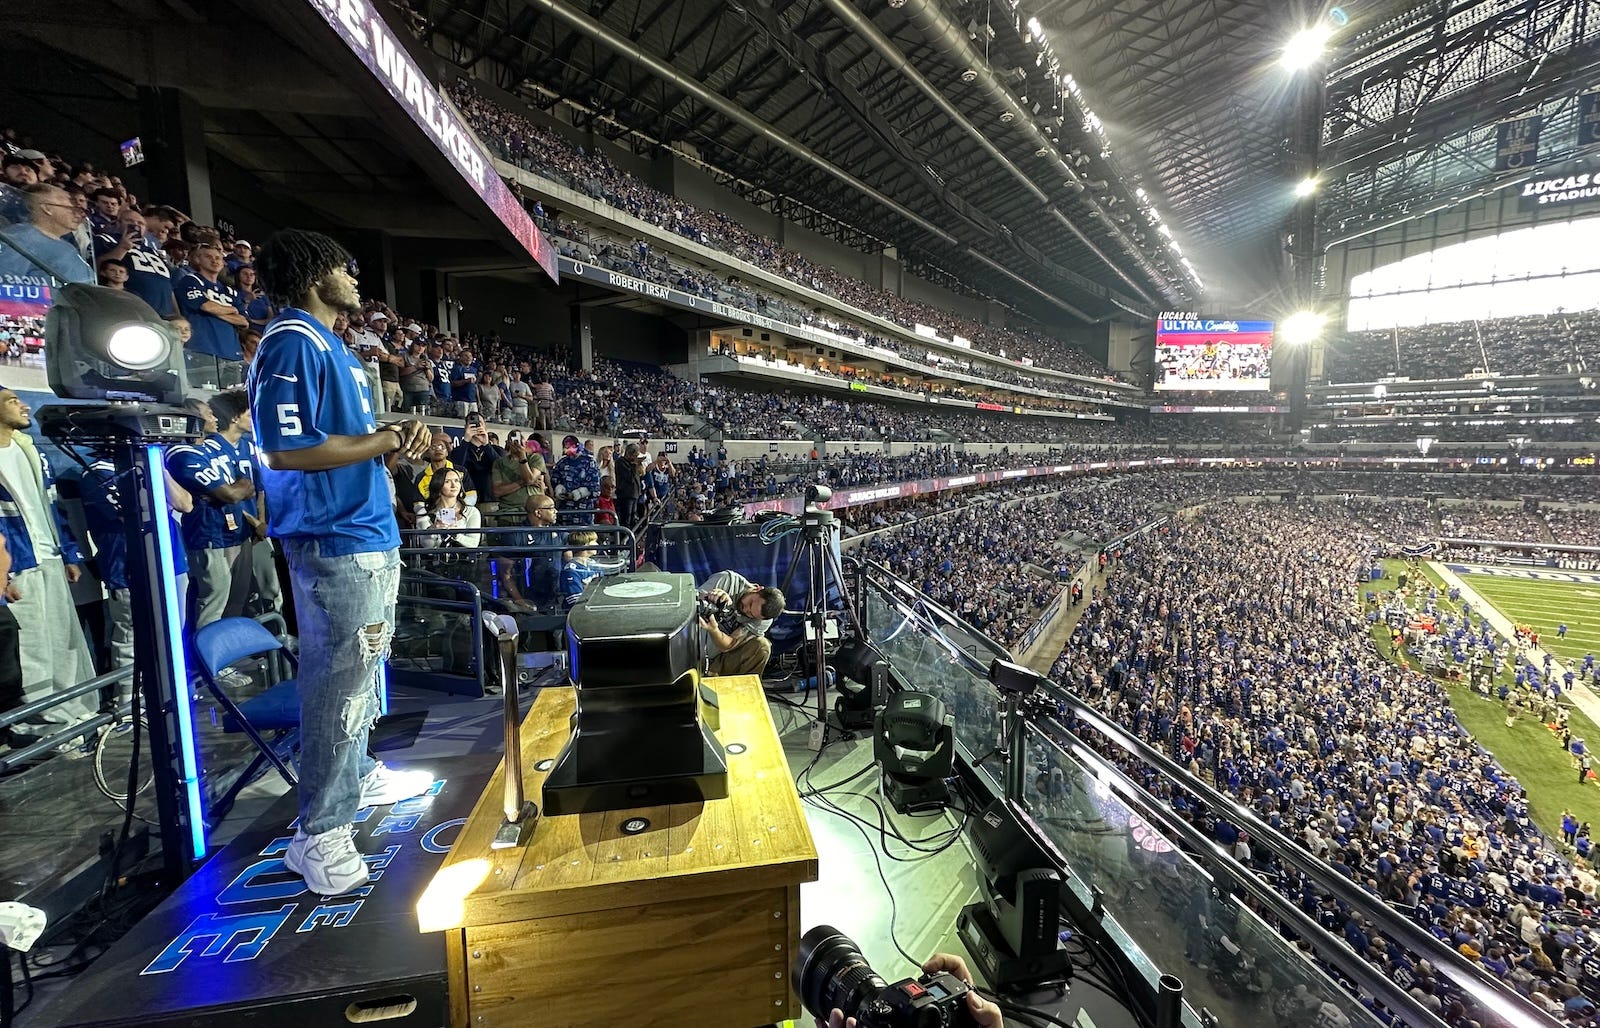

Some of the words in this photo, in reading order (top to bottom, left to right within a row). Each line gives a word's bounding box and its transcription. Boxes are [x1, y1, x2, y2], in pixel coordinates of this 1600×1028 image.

[370, 18, 486, 191] WALKER
[1521, 174, 1590, 197] LUCAS
[217, 219, 235, 236] 406
[130, 248, 171, 280] 28
[609, 273, 644, 293] ROBERT
[645, 283, 670, 300] IRSAY
[712, 303, 727, 316] BILL
[728, 308, 751, 323] BROOKS
[1158, 311, 1185, 320] LUCAS
[1185, 311, 1199, 320] OIL
[1163, 320, 1203, 331] ULTRA
[277, 403, 303, 437] 5
[666, 443, 677, 452] 307
[195, 466, 221, 487] 00
[1430, 877, 1443, 891] 12
[1463, 884, 1475, 898] 53
